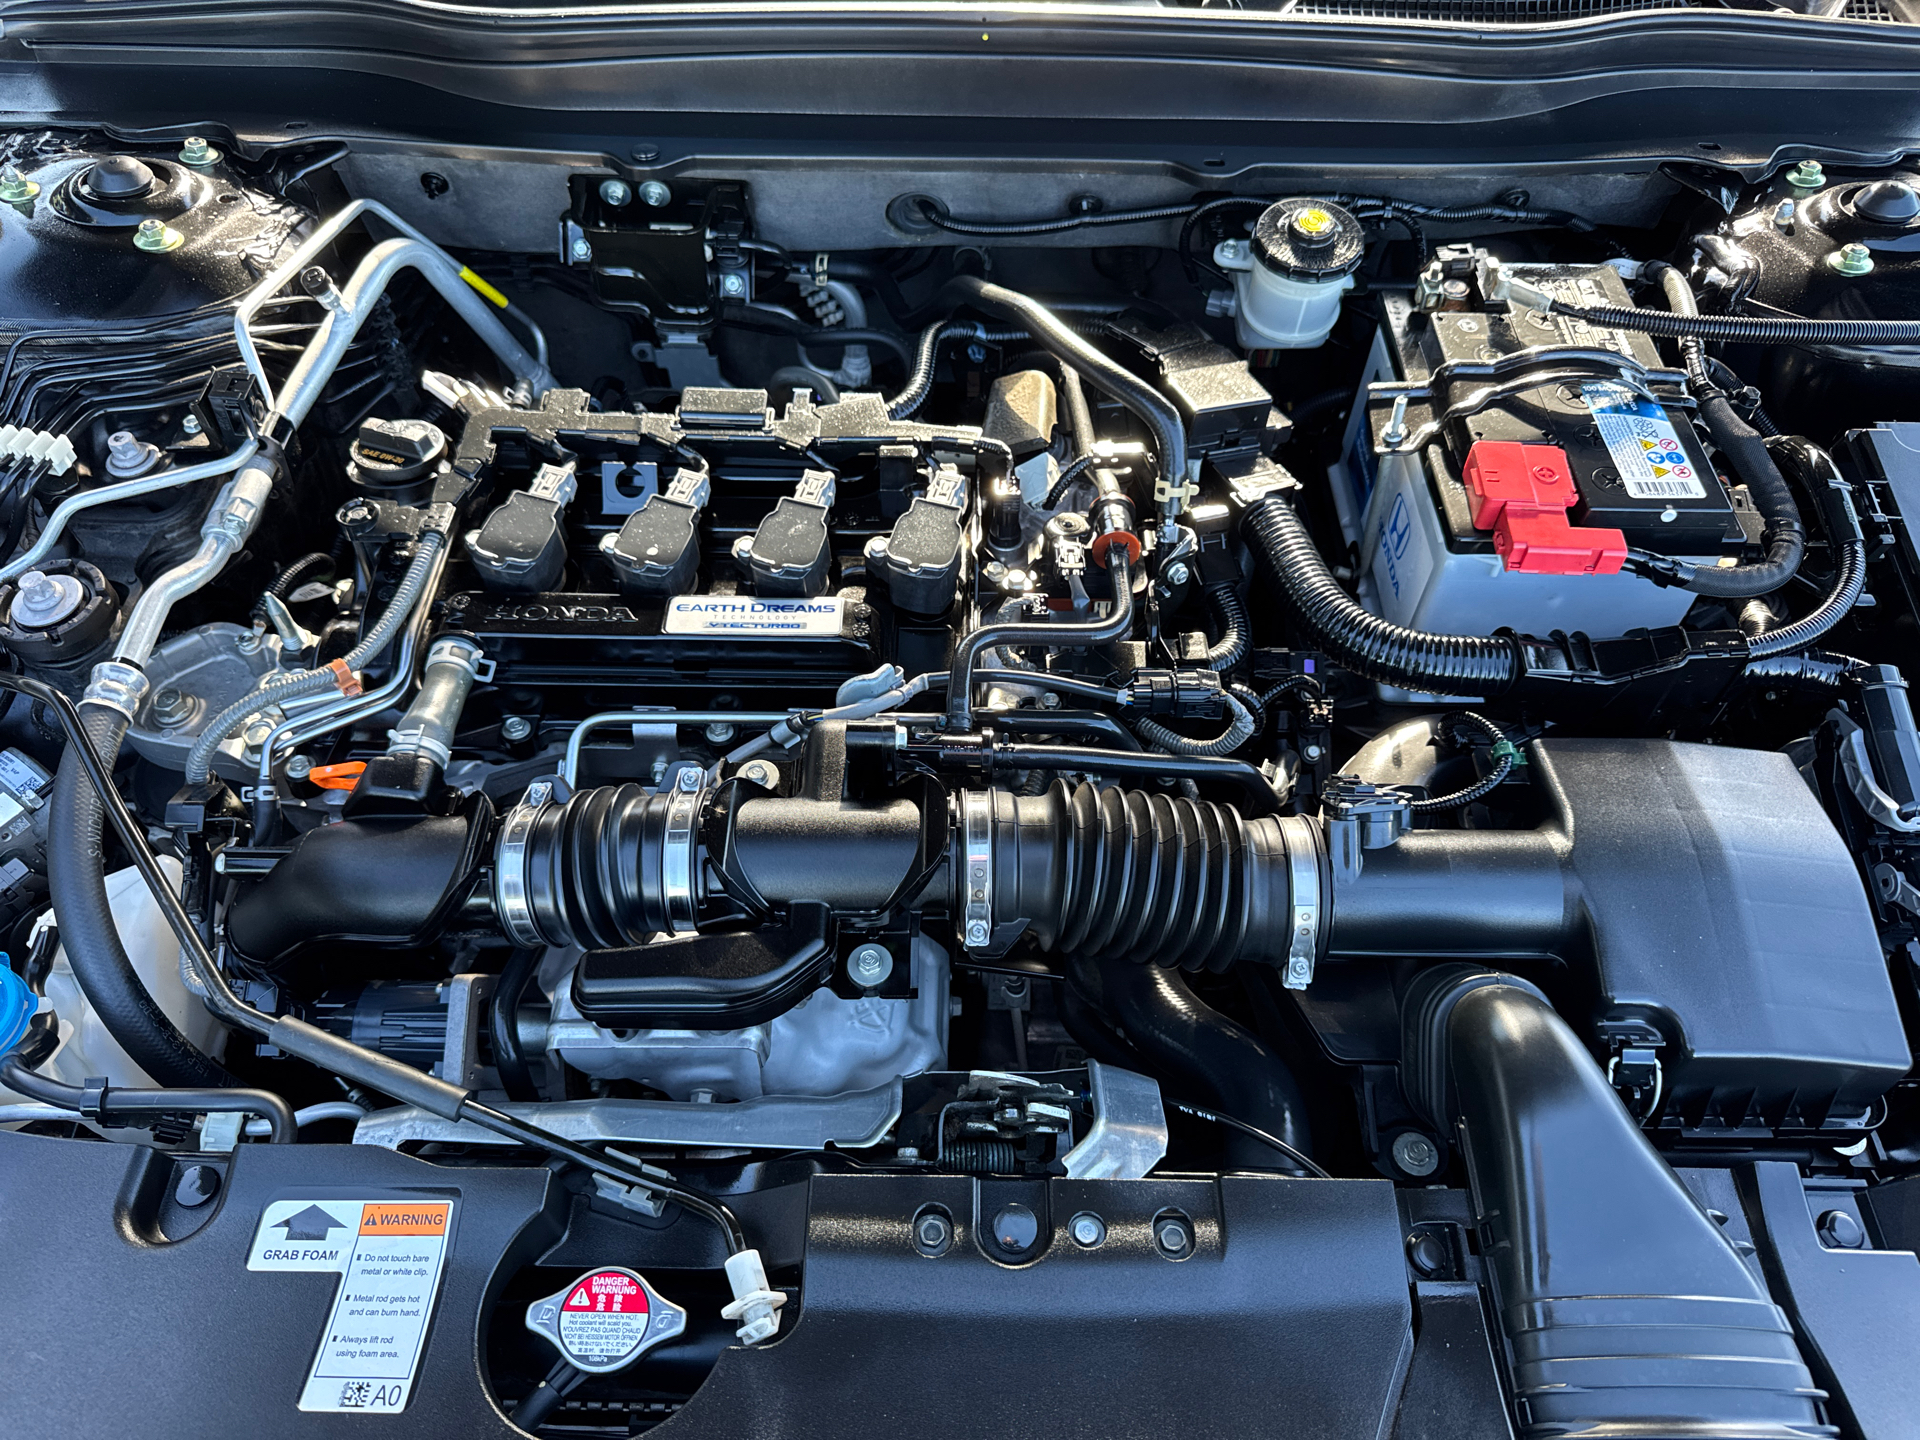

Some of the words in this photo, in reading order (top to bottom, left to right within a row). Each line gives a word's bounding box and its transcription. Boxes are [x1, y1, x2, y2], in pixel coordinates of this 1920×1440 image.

[362, 448, 380, 458] SAE
[380, 452, 405, 463] 0W-20
[676, 604, 746, 612] EARTH
[751, 603, 836, 613] DREAMS
[485, 605, 638, 622] HONDA
[380, 1214, 443, 1226] WARNING
[263, 1250, 299, 1260] GRAB
[302, 1250, 339, 1261] FOAM
[392, 1268, 412, 1276] white
[413, 1268, 428, 1277] clip.
[592, 1276, 629, 1286] DANGER
[592, 1285, 636, 1295] WARNUNG
[353, 1294, 374, 1302] Metal
[389, 1296, 406, 1304] gets
[340, 1336, 368, 1345] Always
[380, 1336, 394, 1344] rod
[336, 1350, 357, 1358] using
[370, 1385, 402, 1406] A0
